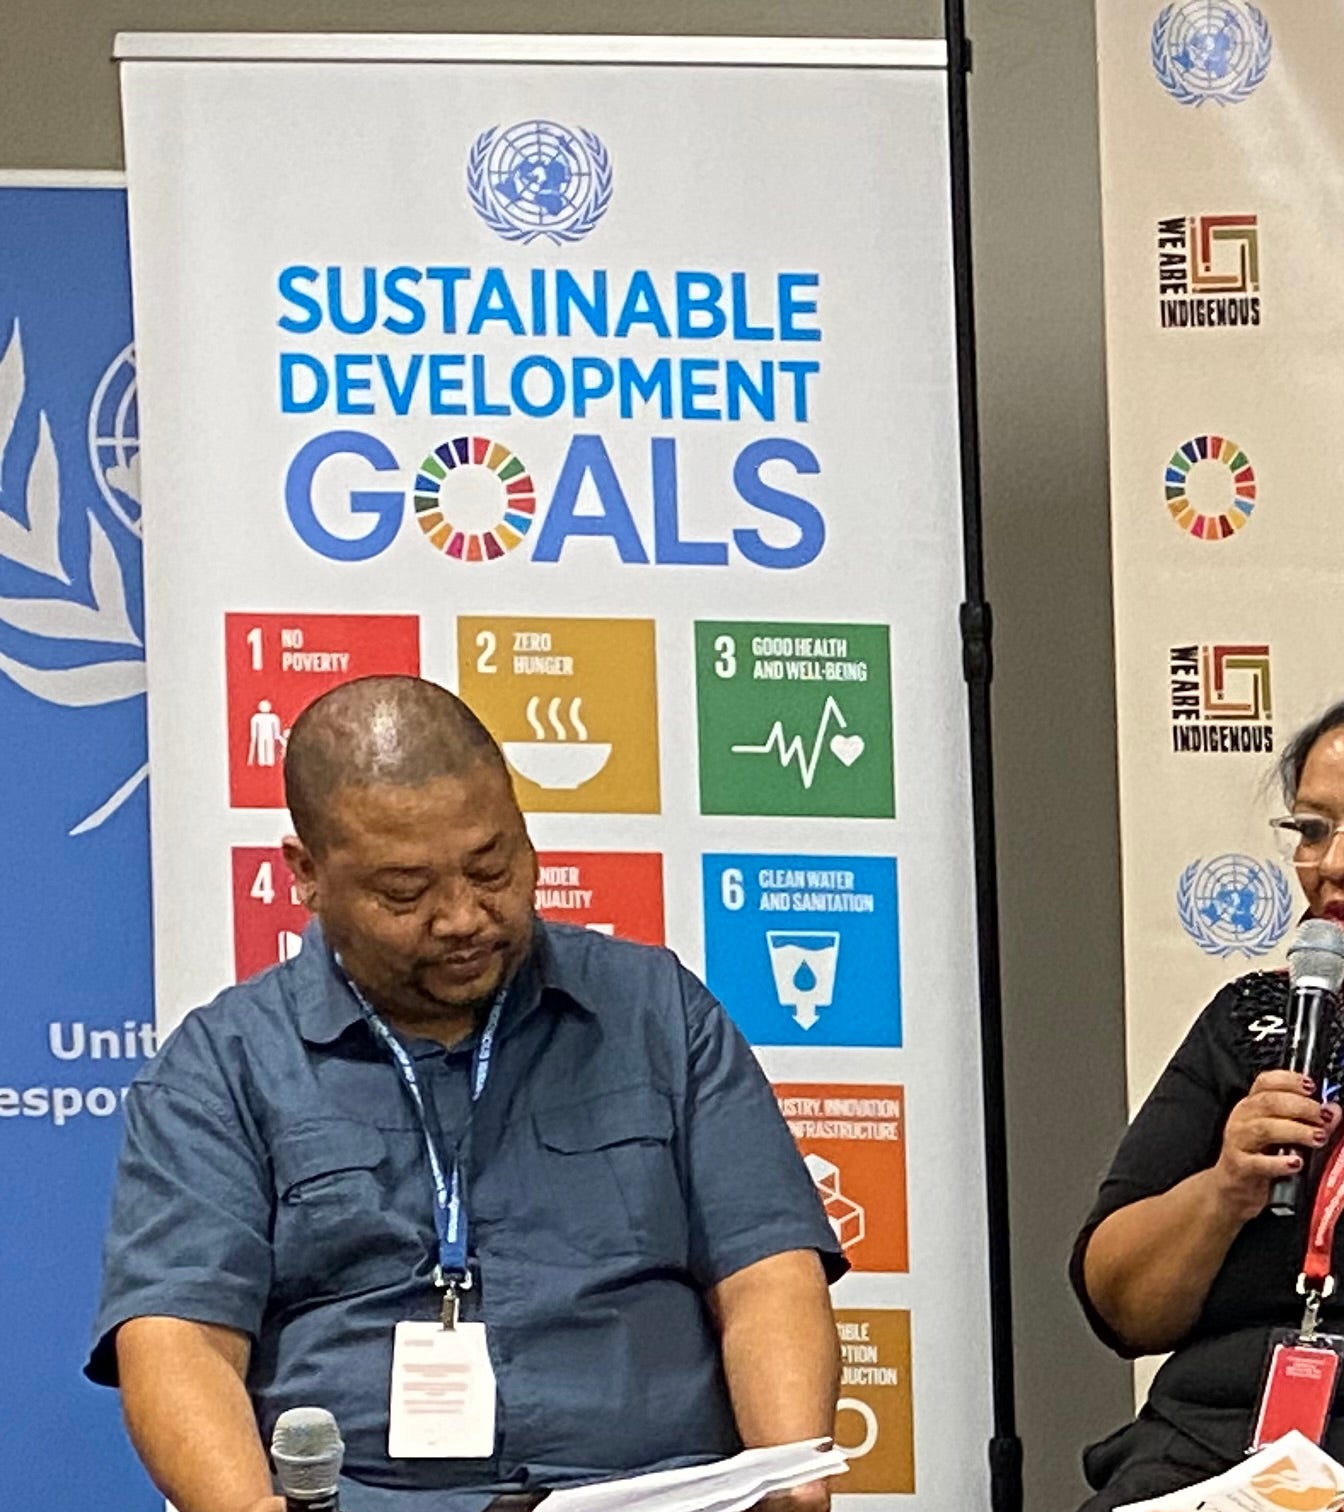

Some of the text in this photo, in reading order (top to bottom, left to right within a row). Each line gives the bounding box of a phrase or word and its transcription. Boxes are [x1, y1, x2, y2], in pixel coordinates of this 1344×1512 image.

[277, 265, 822, 342] SUSTAINABLE
[1160, 297, 1260, 328] INDIGENOUS
[280, 353, 820, 422] DEVELOPMENT
[284, 429, 826, 570] GOALS
[247, 627, 263, 671] 1
[281, 628, 304, 649] NO
[476, 630, 497, 674] 2
[512, 632, 552, 652] ZERO
[752, 637, 847, 658] GOOD HEALTH
[282, 651, 350, 673] POVERTY
[513, 655, 574, 675] HUNGER
[714, 635, 737, 678] 3
[754, 660, 868, 682] AND WELL-BEING
[1172, 724, 1273, 753] INDIGENOUS
[250, 861, 275, 904] 4
[537, 866, 580, 886] NDER
[721, 868, 745, 911] 6
[758, 869, 855, 890] CLEAN WATER
[760, 893, 874, 912] AND SANITATION
[0, 1086, 131, 1126] espo
